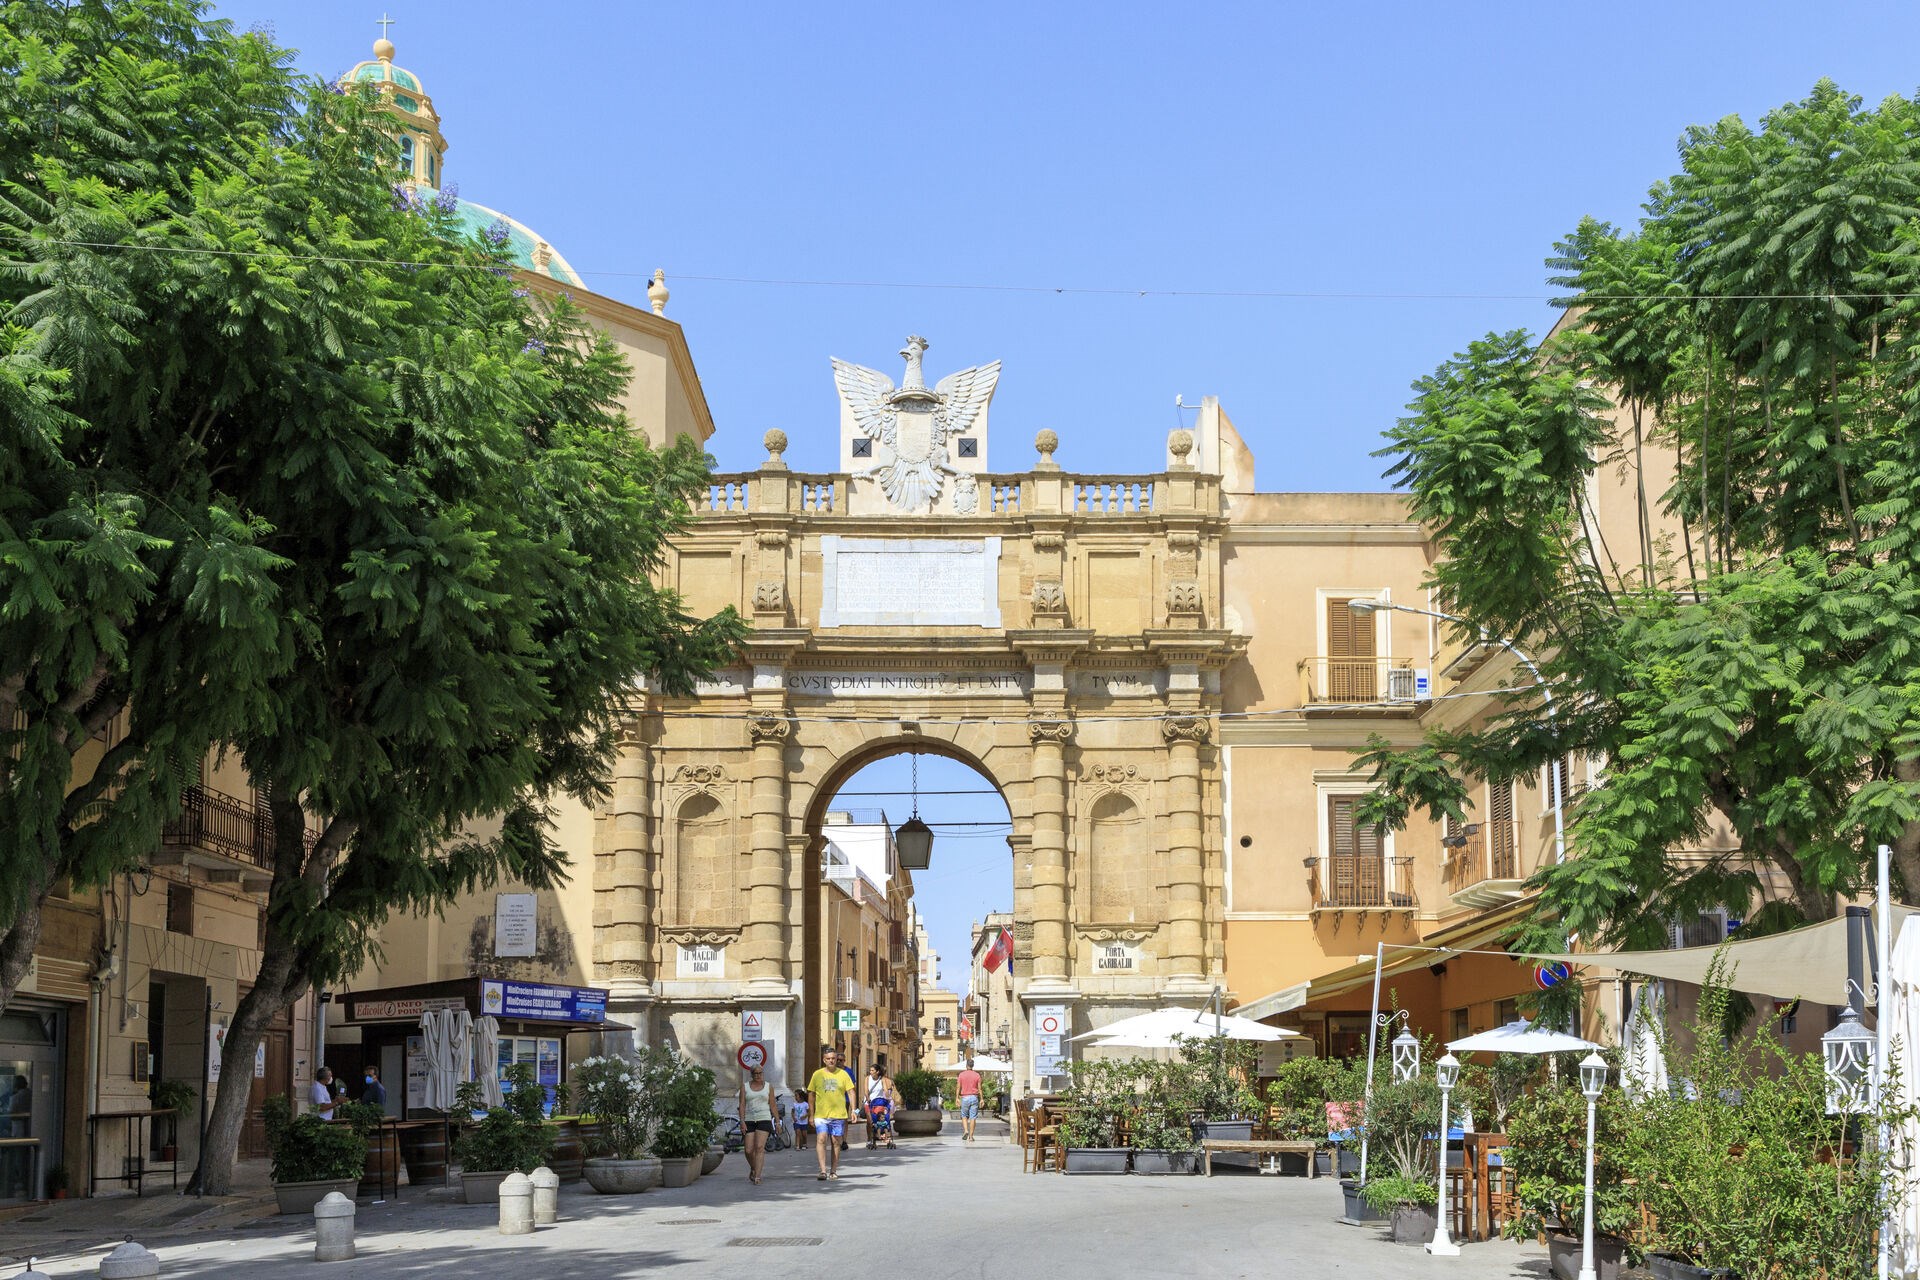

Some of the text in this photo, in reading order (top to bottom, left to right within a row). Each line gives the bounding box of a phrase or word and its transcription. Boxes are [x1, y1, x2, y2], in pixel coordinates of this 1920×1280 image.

[788, 676, 875, 689] CVSTODIAT
[957, 676, 975, 689] ET
[1092, 676, 1136, 688] TVVM
[692, 950, 718, 961] MAGGIO
[1105, 947, 1125, 957] PORTA
[693, 962, 709, 972] 1860
[1098, 958, 1132, 968] GARIBALDI
